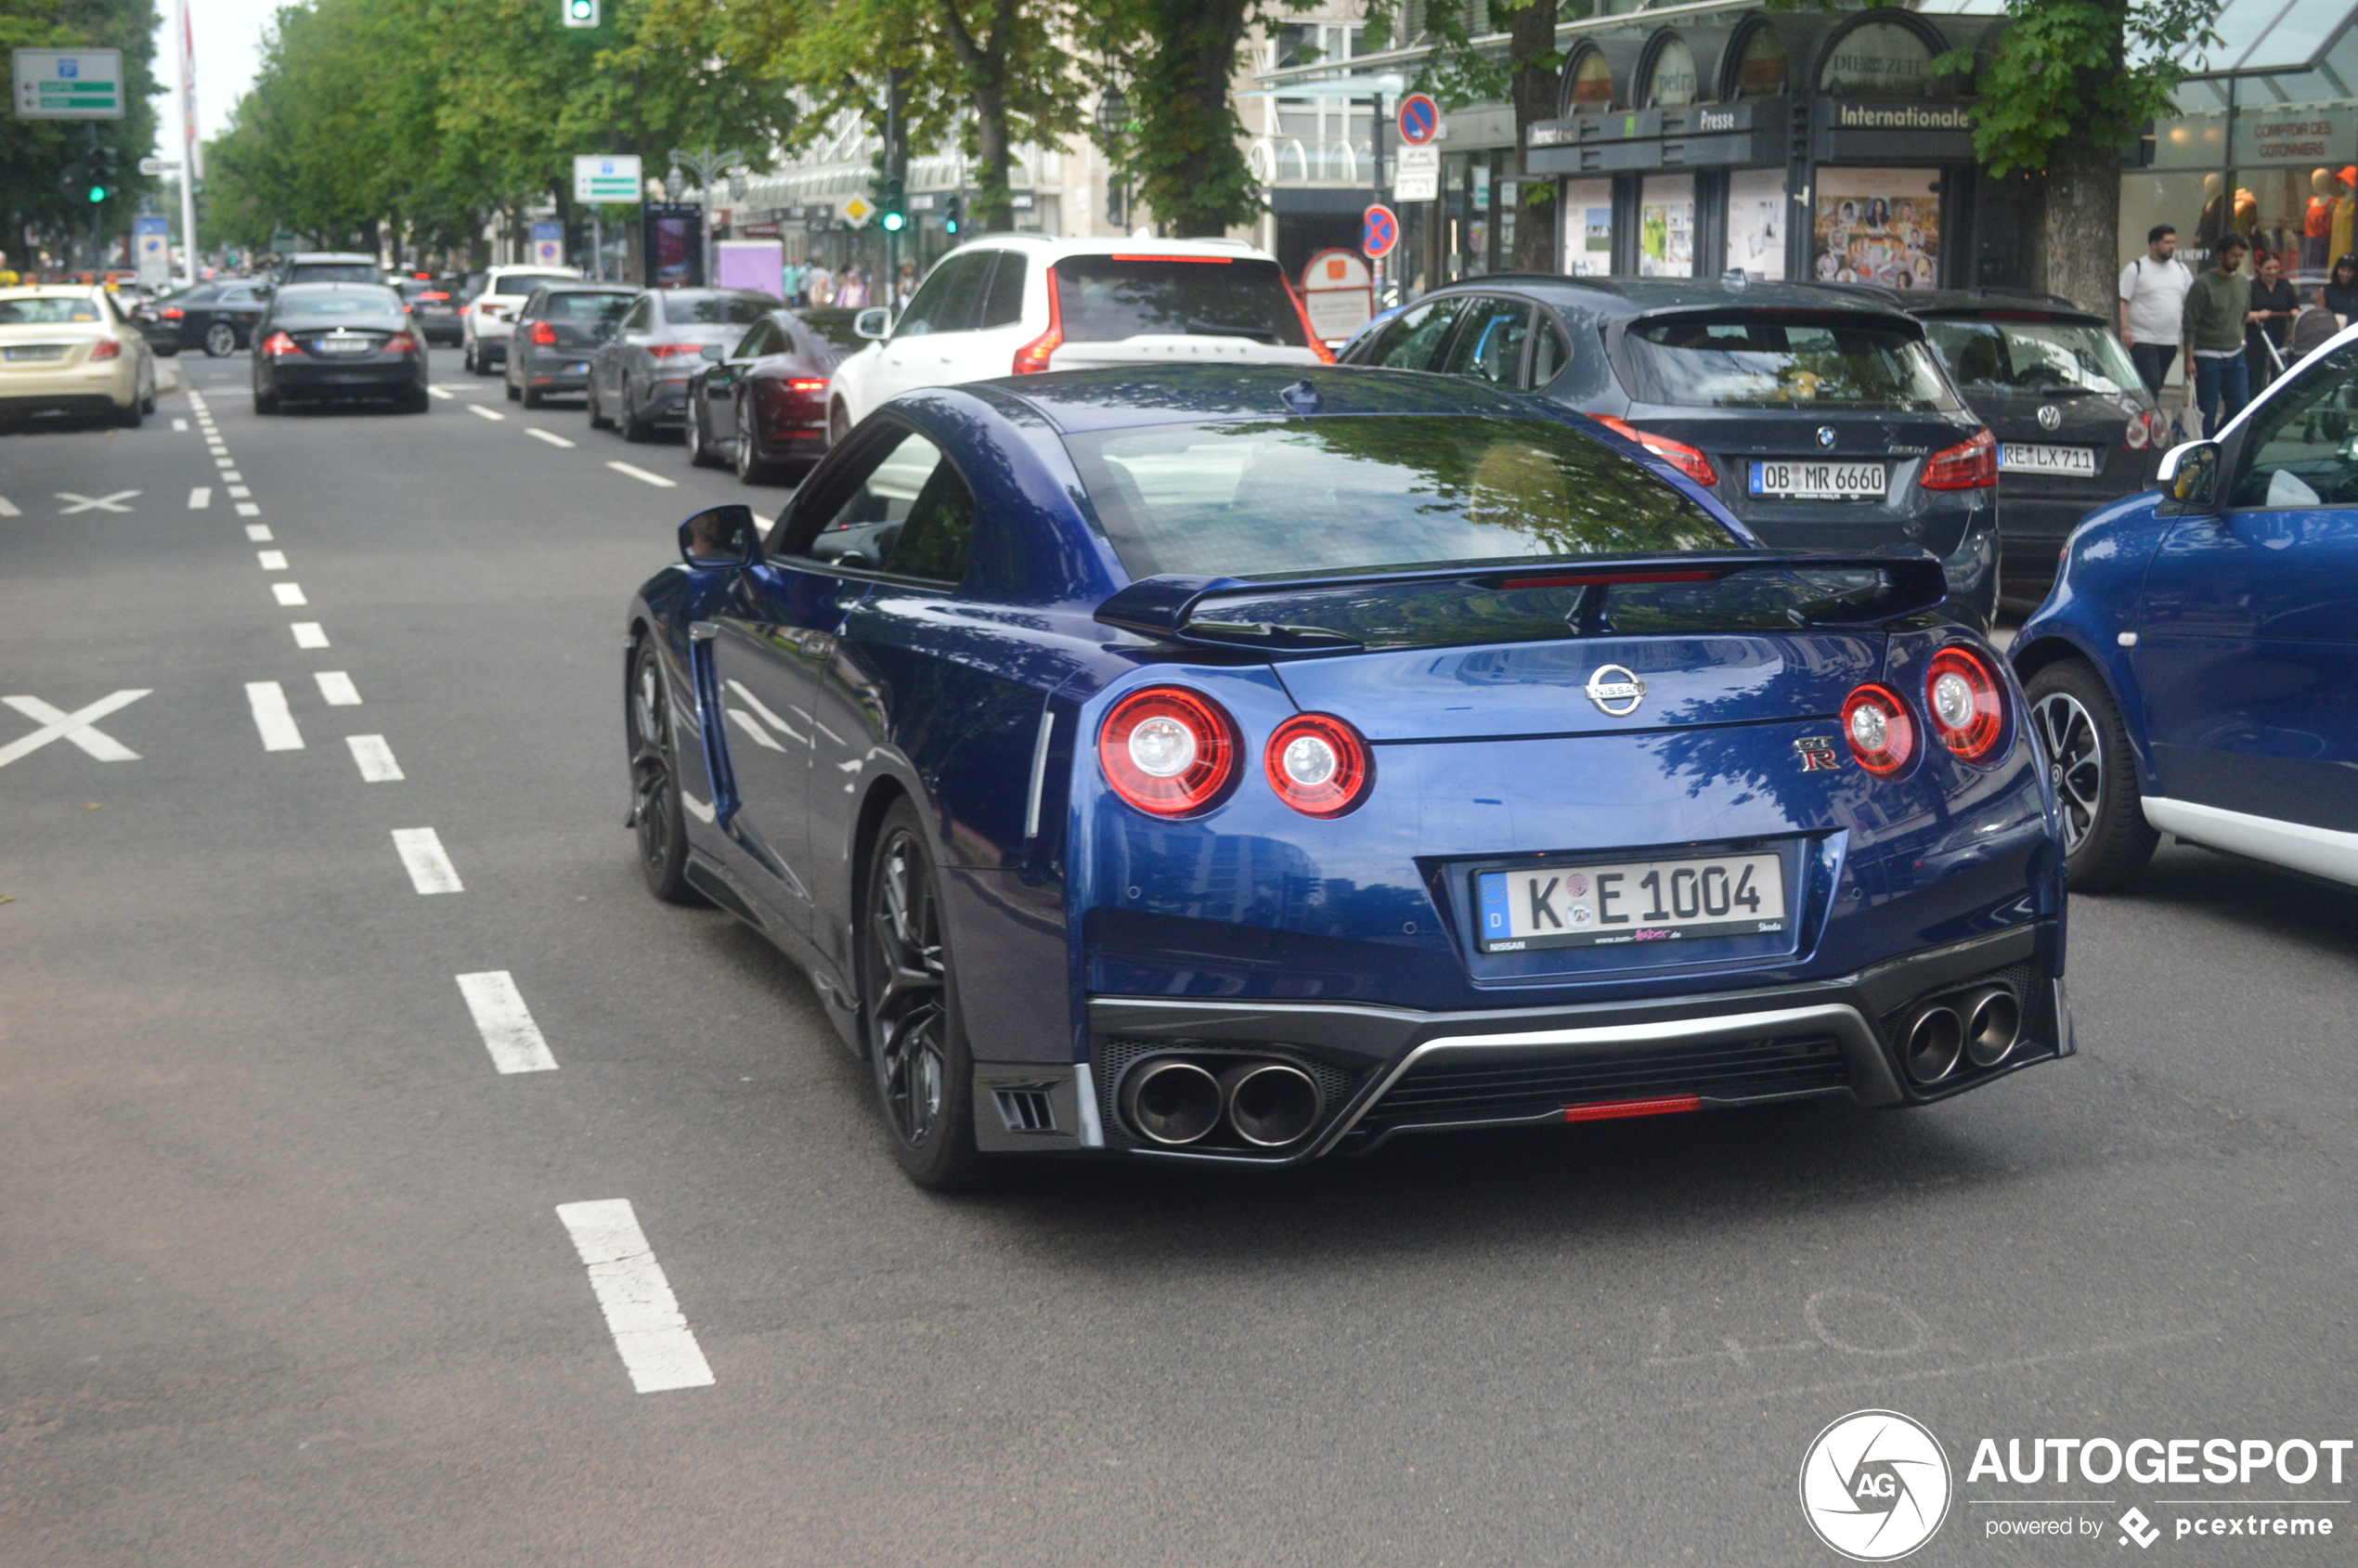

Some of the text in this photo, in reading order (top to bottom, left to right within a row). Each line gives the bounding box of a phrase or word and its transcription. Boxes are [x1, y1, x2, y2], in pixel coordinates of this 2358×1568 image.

[1700, 110, 1735, 130] Presse
[1841, 104, 1969, 127] Internationale
[2003, 446, 2092, 469] RE LX 711
[1765, 465, 1883, 490] OB MR 6660
[1594, 685, 1640, 696] NISSAN
[1529, 877, 1562, 930] K
[1490, 913, 1502, 927] D
[1489, 940, 1526, 952] NISSAN
